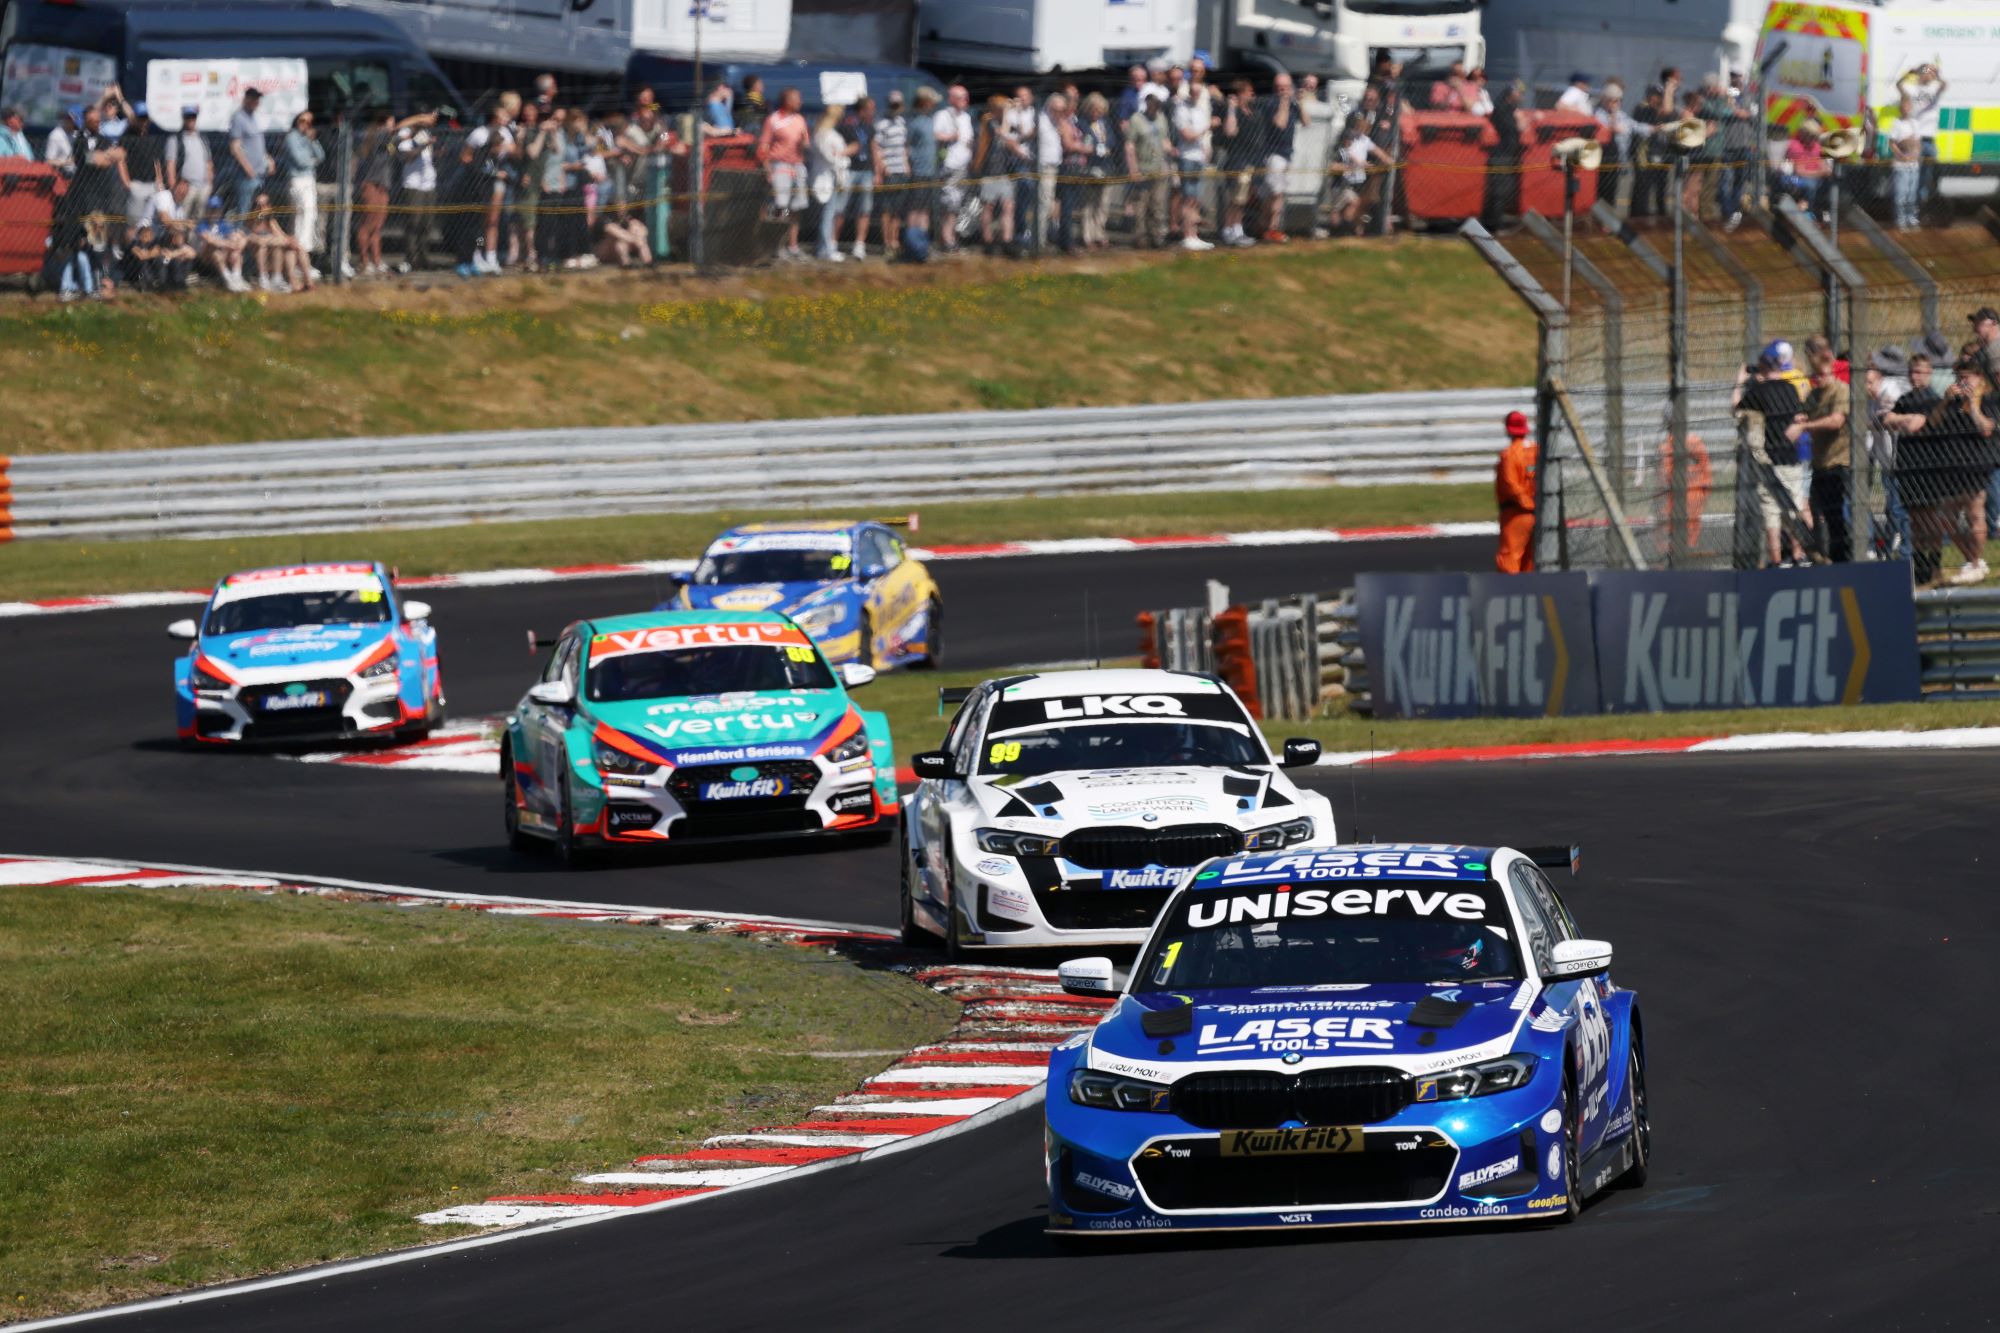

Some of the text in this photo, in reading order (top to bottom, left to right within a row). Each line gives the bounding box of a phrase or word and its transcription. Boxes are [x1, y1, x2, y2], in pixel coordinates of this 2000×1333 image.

[1623, 587, 1838, 714] KwikFit
[1044, 695, 1189, 719] LKQ
[676, 745, 805, 765] Hansford Sensors
[989, 742, 1022, 764] 99
[706, 779, 775, 800] KwikFit
[1100, 800, 1193, 808] COGNITION
[1102, 806, 1137, 814] LAND
[1224, 852, 1458, 876] LASER
[1297, 867, 1381, 879] TOOLS
[1162, 942, 1183, 969] 1
[1199, 1017, 1394, 1046] LASER
[1259, 1038, 1330, 1051] TOOLS
[1428, 1051, 1483, 1069] LIQUI MOLY
[1109, 1062, 1159, 1078] LIQUI MOLY
[1171, 1149, 1191, 1158] TOW
[1396, 1142, 1417, 1150] TOW
[1459, 1155, 1519, 1188] JELLYFISH
[1420, 1202, 1508, 1218] candeo vision
[1089, 1216, 1132, 1230] candeo
[1137, 1215, 1171, 1228] vision
